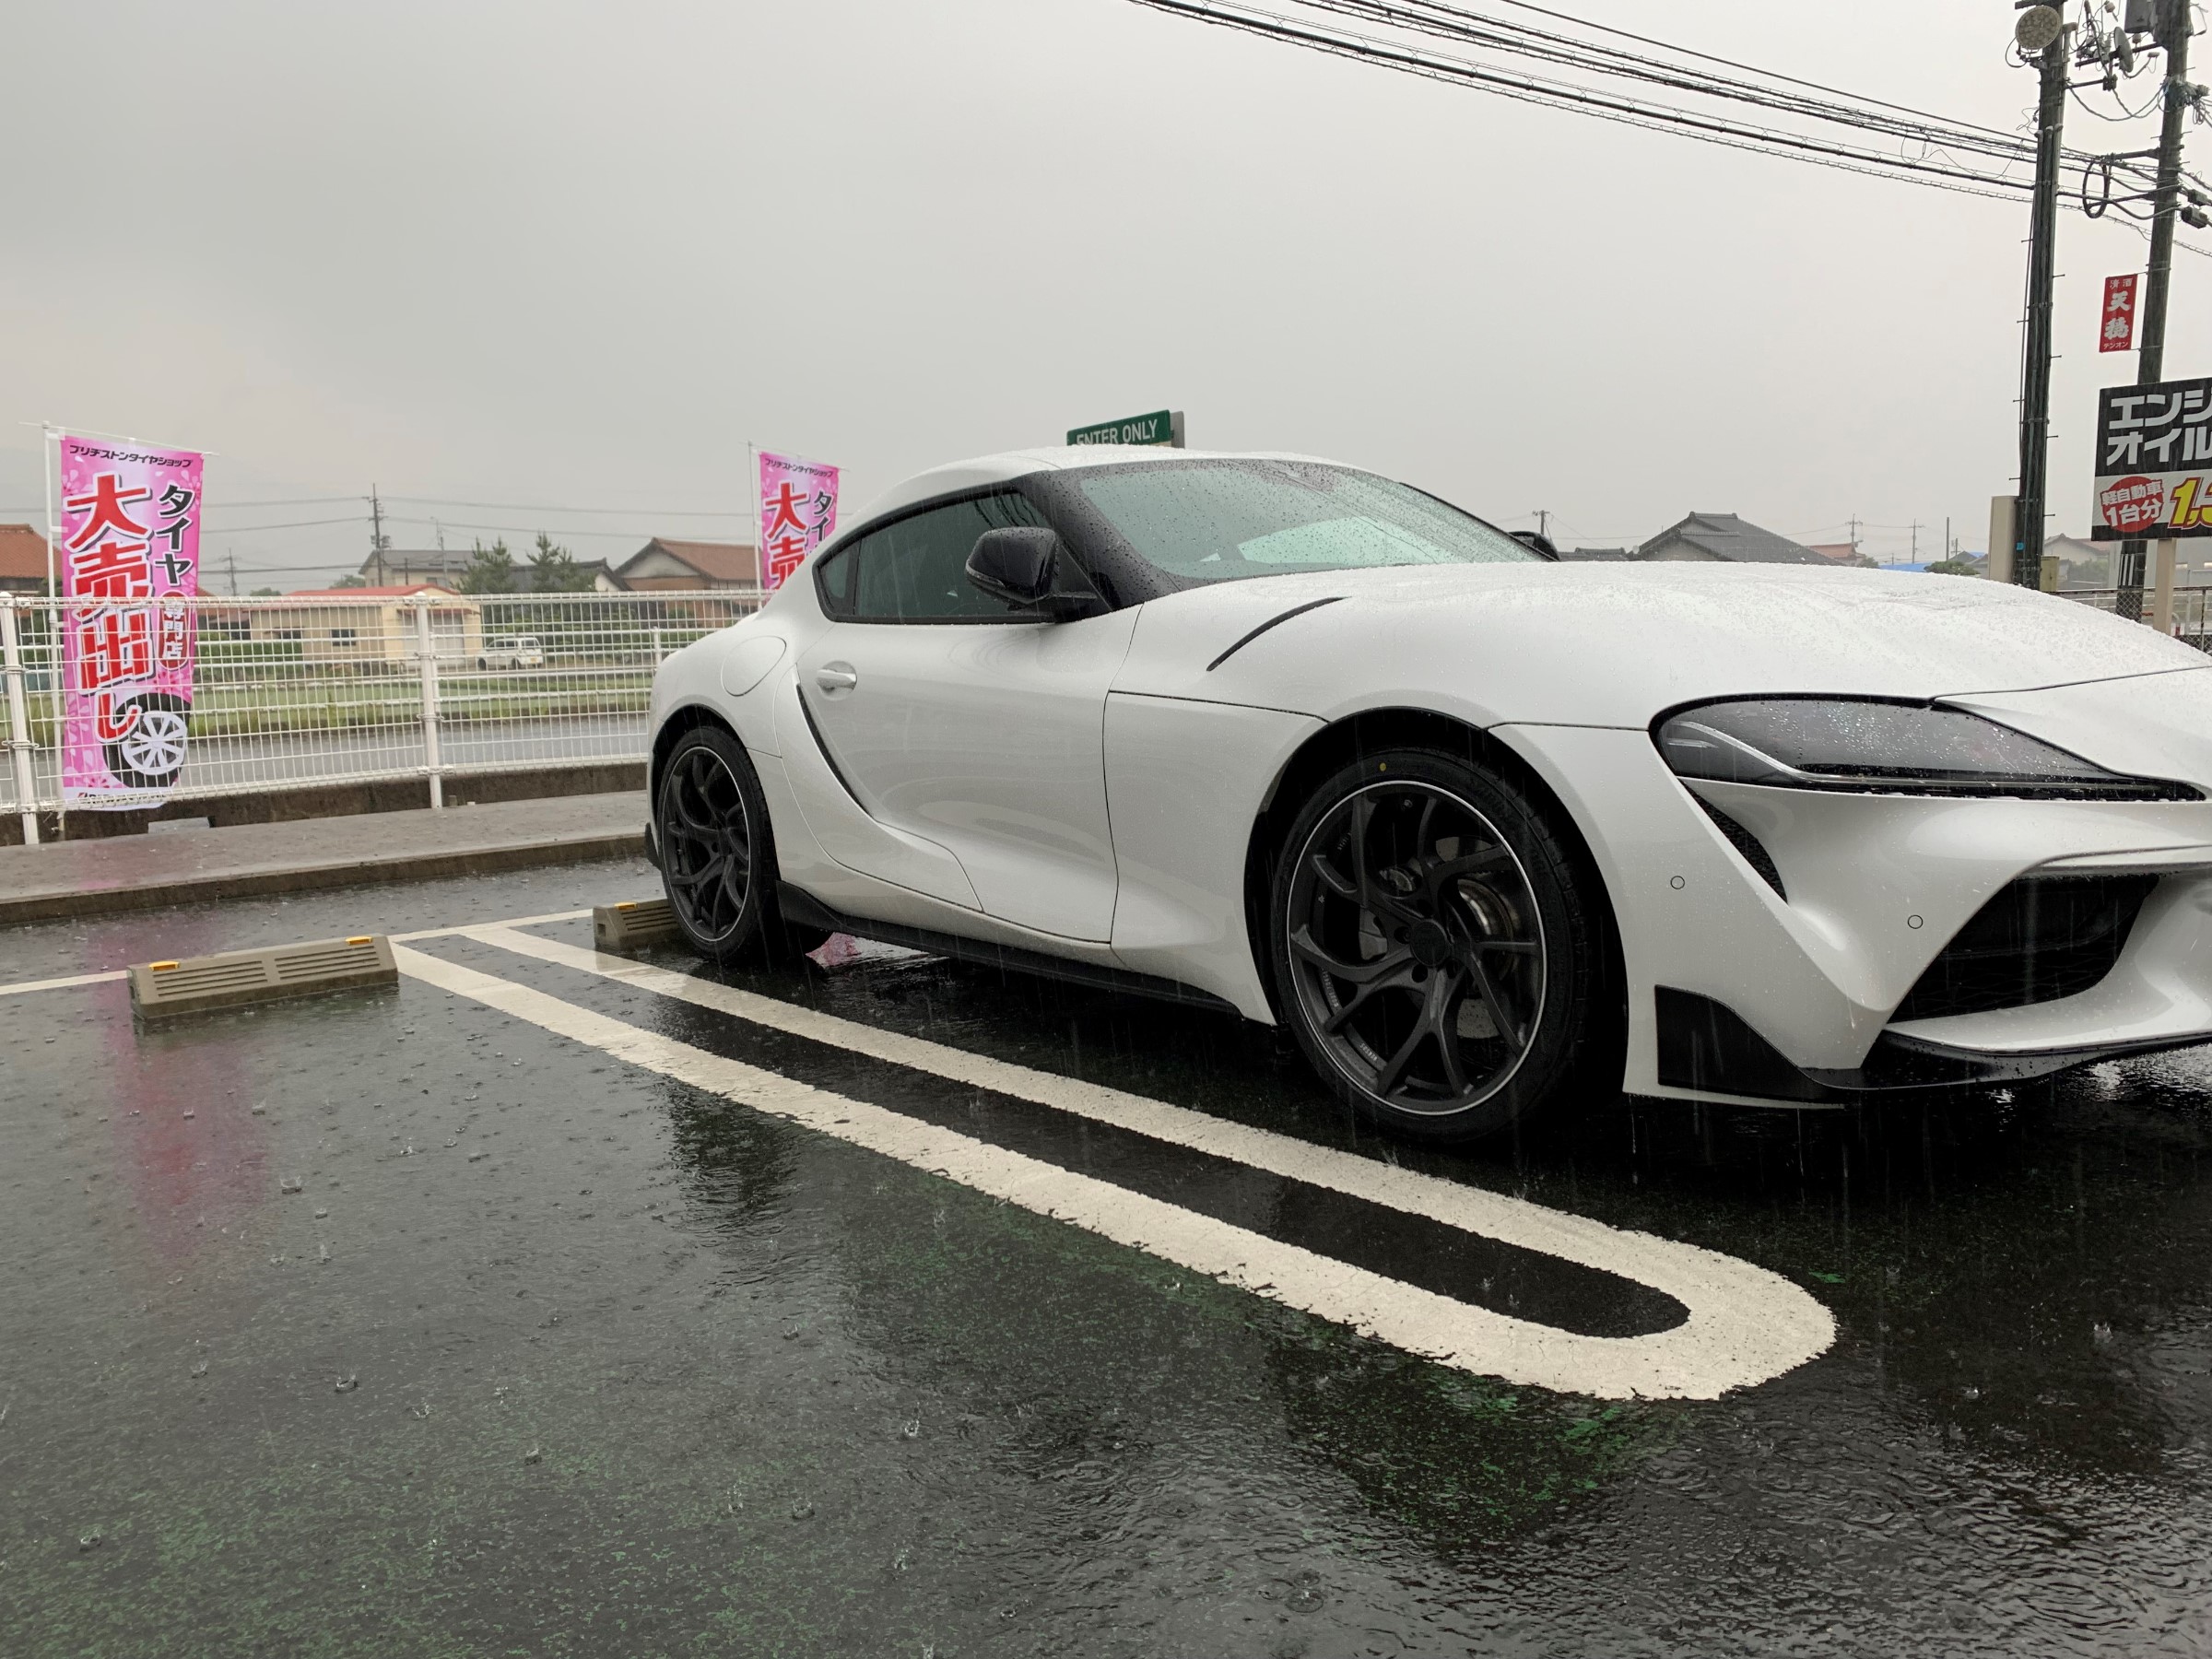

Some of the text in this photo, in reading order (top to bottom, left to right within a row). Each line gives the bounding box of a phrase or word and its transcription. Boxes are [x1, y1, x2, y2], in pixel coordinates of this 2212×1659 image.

[1077, 418, 1158, 445] ENTER ONLY
[2106, 426, 2212, 466] オイル
[2106, 498, 2162, 527] 1台分
[155, 484, 194, 584] タイヤ
[66, 473, 153, 741] 大売出し
